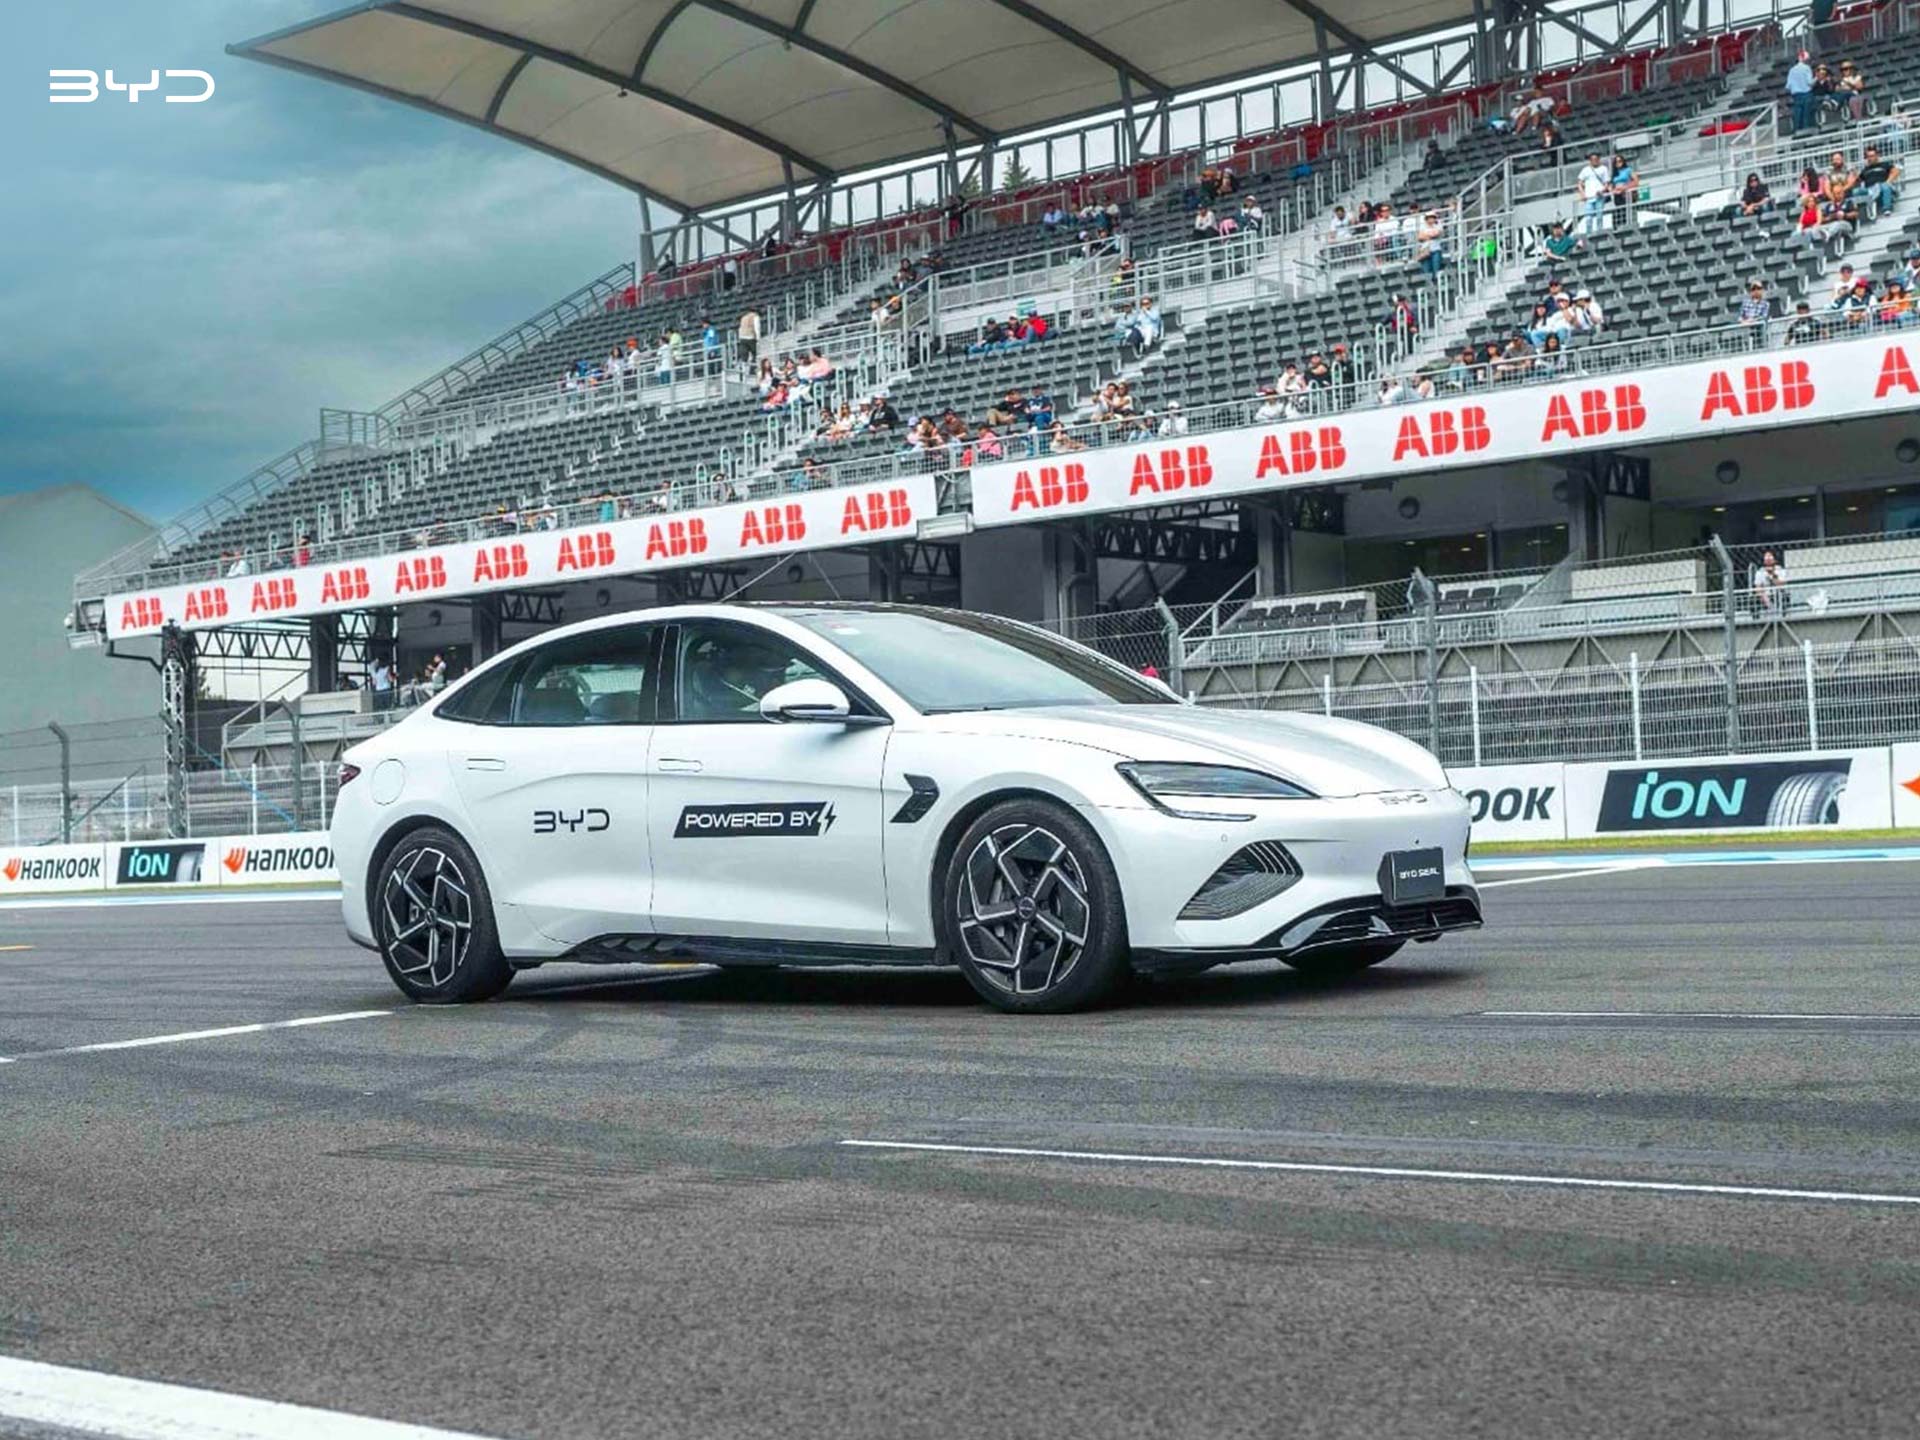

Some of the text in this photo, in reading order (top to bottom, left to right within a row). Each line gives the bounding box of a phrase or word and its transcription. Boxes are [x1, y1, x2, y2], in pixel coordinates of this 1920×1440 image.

[1011, 463, 1089, 511] ABB
[1130, 445, 1213, 495] ABB
[1256, 427, 1346, 479] ABB
[1393, 406, 1490, 461] ABB
[1542, 384, 1647, 442] ABB
[1701, 361, 1815, 420] ABB
[122, 489, 911, 629] ABB ABB ABB ABB ABB ABB ABB ABB ABB ABB
[533, 808, 610, 833] BYD
[685, 810, 818, 829] POWERED BY
